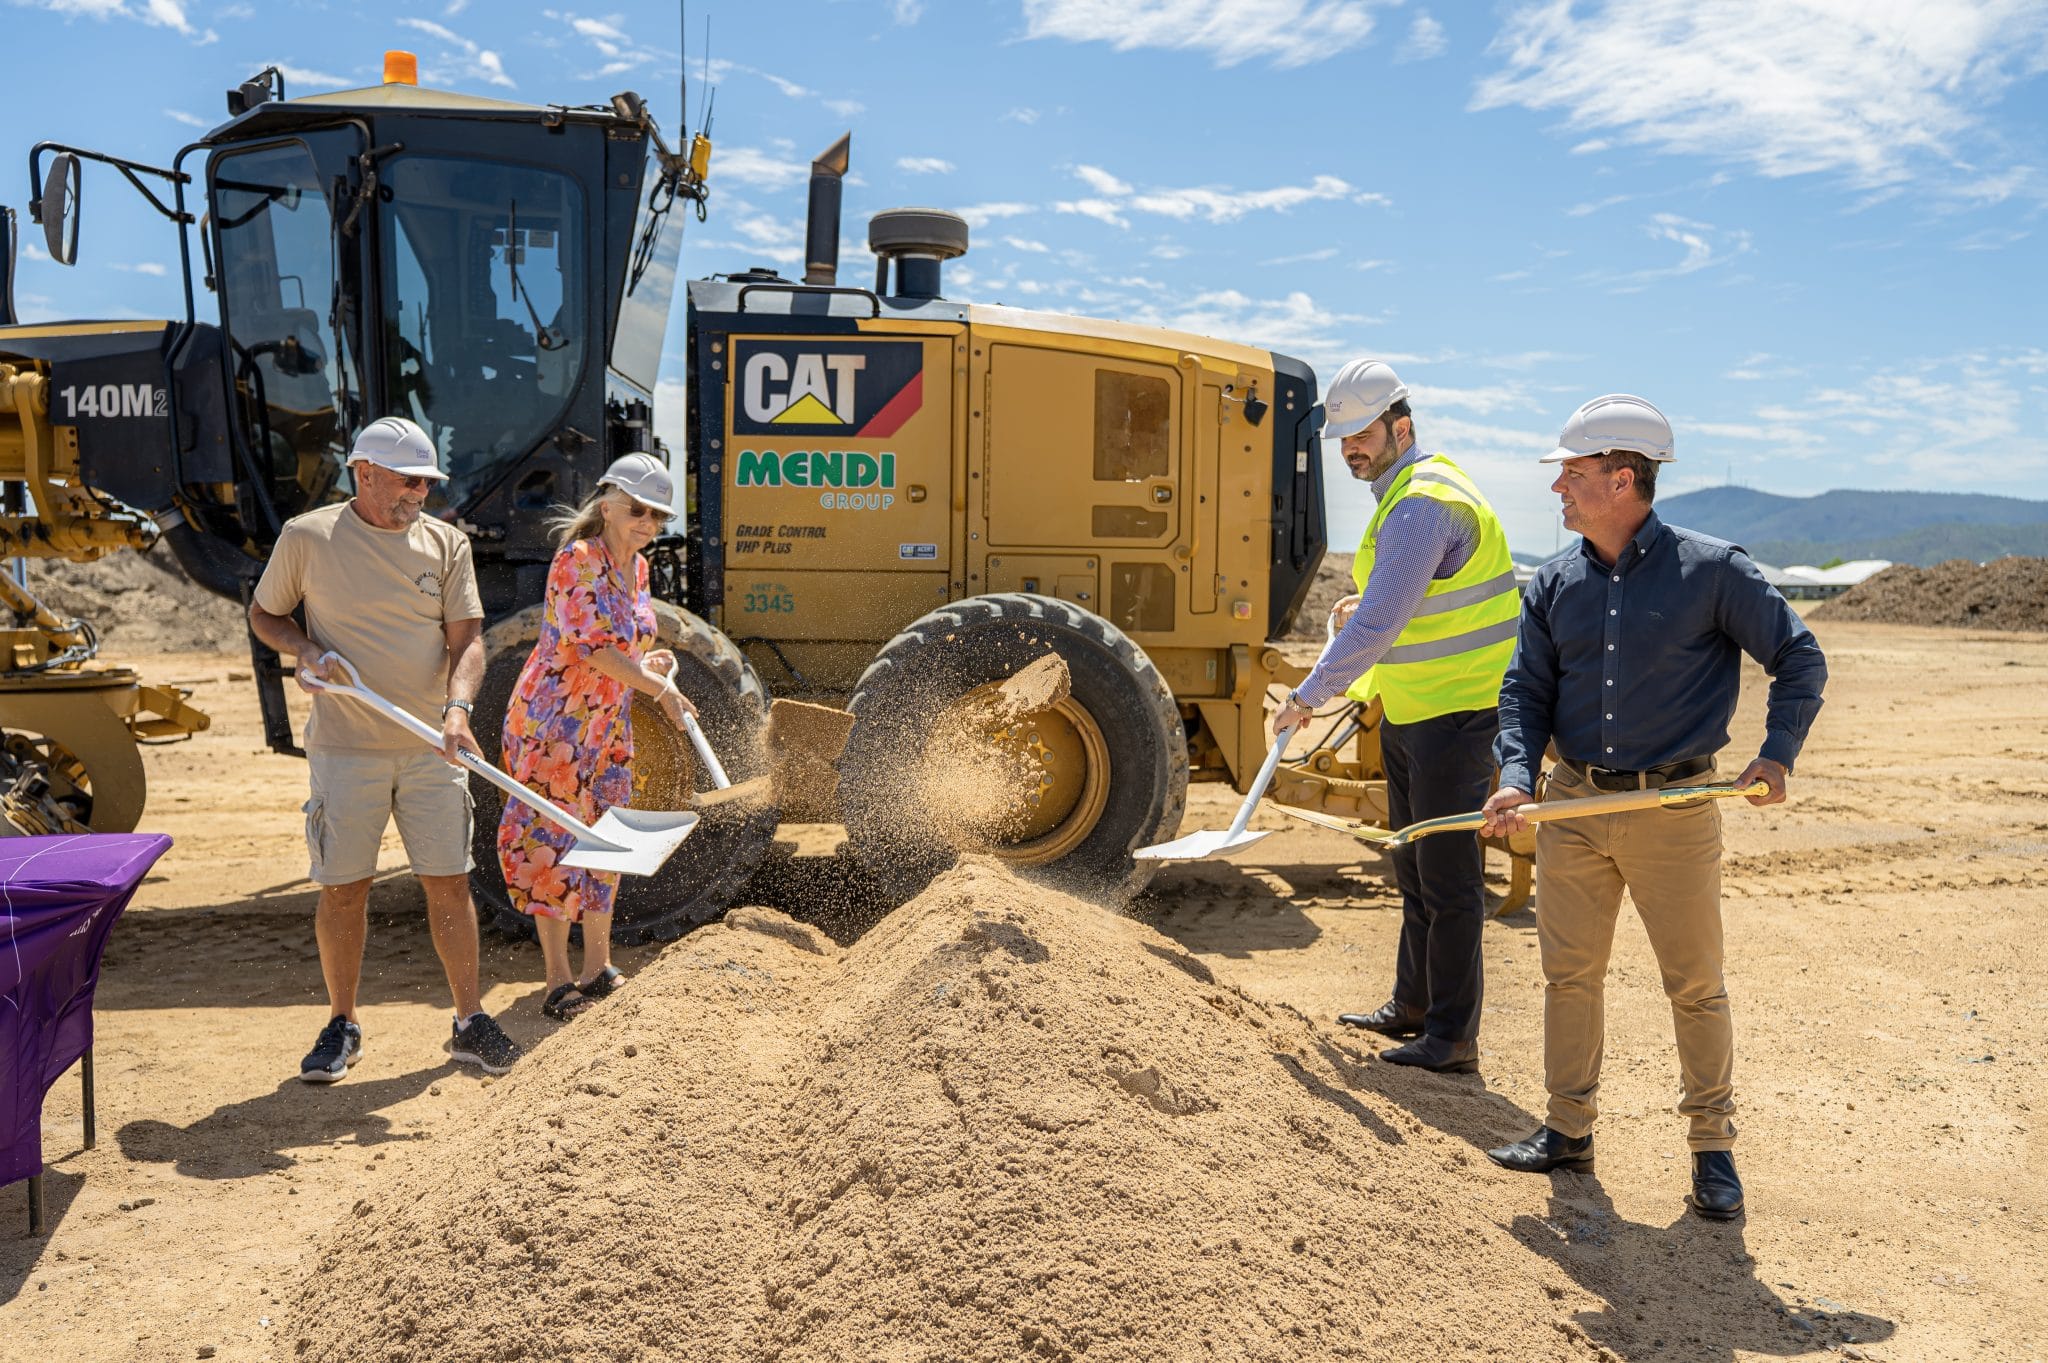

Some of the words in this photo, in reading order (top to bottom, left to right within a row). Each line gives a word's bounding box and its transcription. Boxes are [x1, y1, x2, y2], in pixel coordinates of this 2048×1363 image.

[743, 352, 866, 425] CAT
[735, 449, 896, 489] MENDI
[820, 492, 895, 511] GROUP
[735, 540, 761, 553] VHP
[743, 593, 795, 613] 3345
